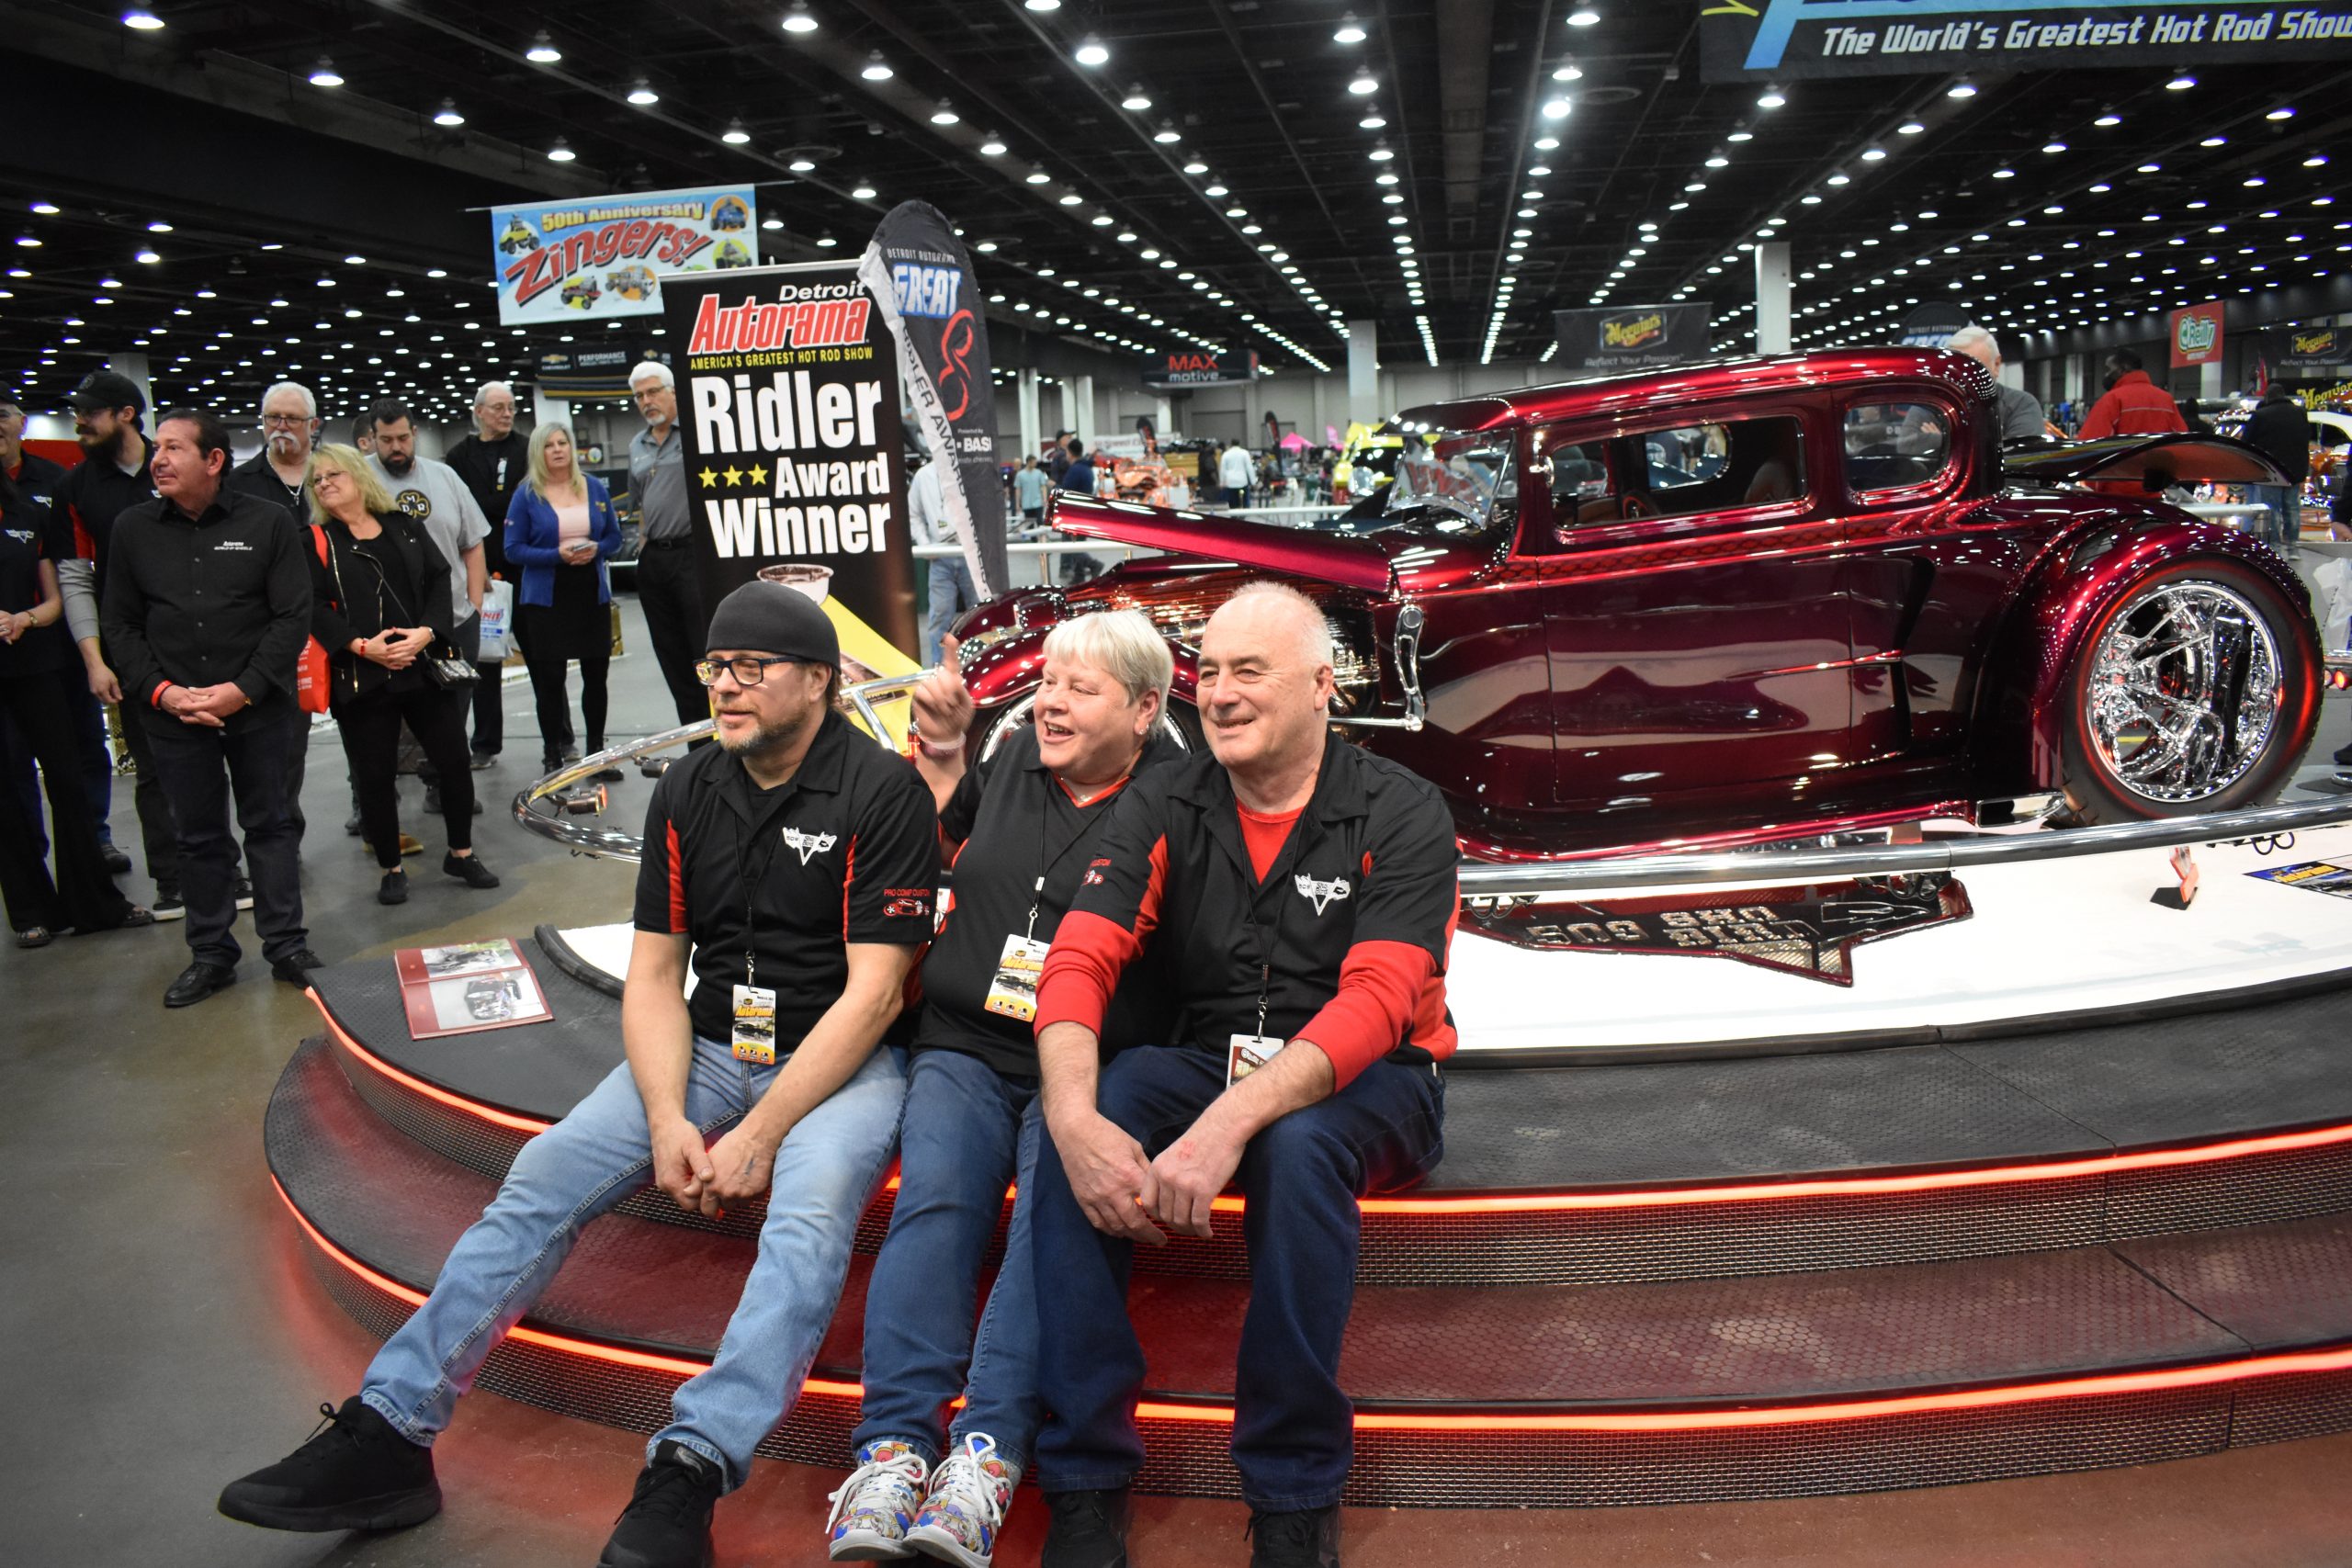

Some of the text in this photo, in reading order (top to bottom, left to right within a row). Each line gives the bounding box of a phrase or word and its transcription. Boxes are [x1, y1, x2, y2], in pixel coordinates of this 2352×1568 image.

[1823, 11, 2352, 56] The World's Greatest Hot Rod Show
[541, 202, 704, 232] 50th Anniversary
[504, 219, 714, 308] Zingers!
[887, 248, 956, 264] DETROIT AUTORAMA
[779, 281, 866, 301] Detroit
[892, 264, 962, 318] GREAT
[687, 293, 871, 355] Autorama
[691, 347, 872, 370] AMERICA'S GREATEST HOT ROD SHOW
[1169, 354, 1218, 371] MAX
[1169, 369, 1219, 382] motive
[1620, 355, 1641, 365] Your
[691, 370, 882, 454] Ridler
[775, 452, 890, 499] Award
[705, 497, 890, 558] Winner
